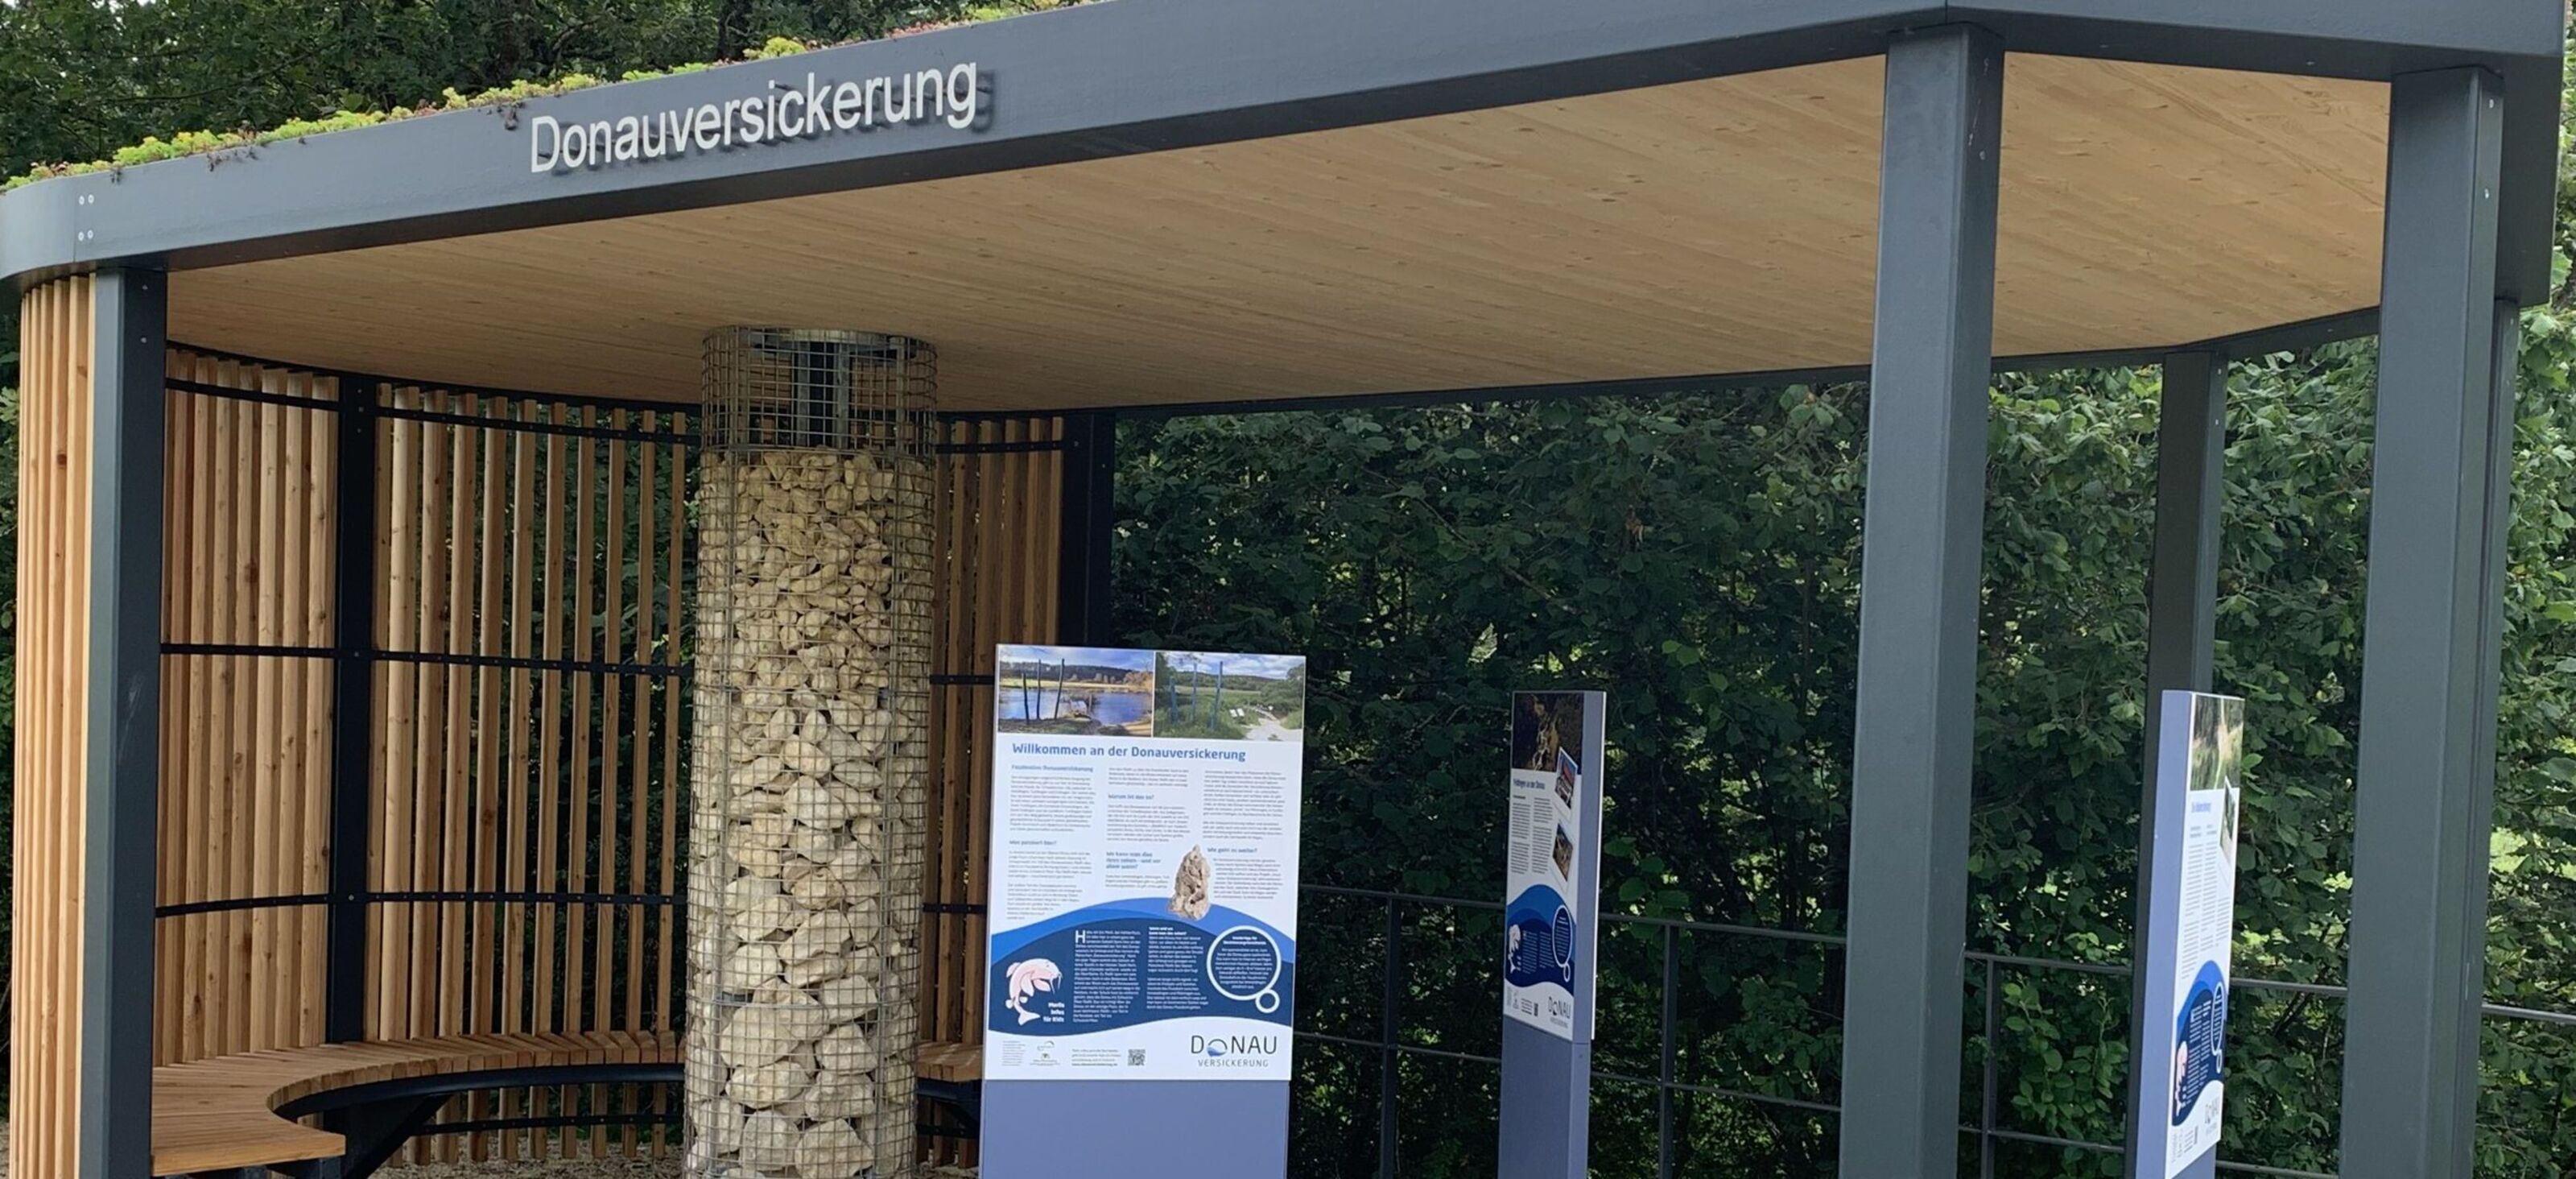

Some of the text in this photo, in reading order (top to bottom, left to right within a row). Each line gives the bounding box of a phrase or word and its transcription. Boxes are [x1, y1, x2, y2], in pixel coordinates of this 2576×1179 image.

[530, 62, 976, 173] Donauversickerung
[1012, 743, 1246, 763] Willkommen an der Donauversickerung
[1191, 1034, 1278, 1057] DONAU
[1197, 1058, 1269, 1068] VERSICKERUNG
